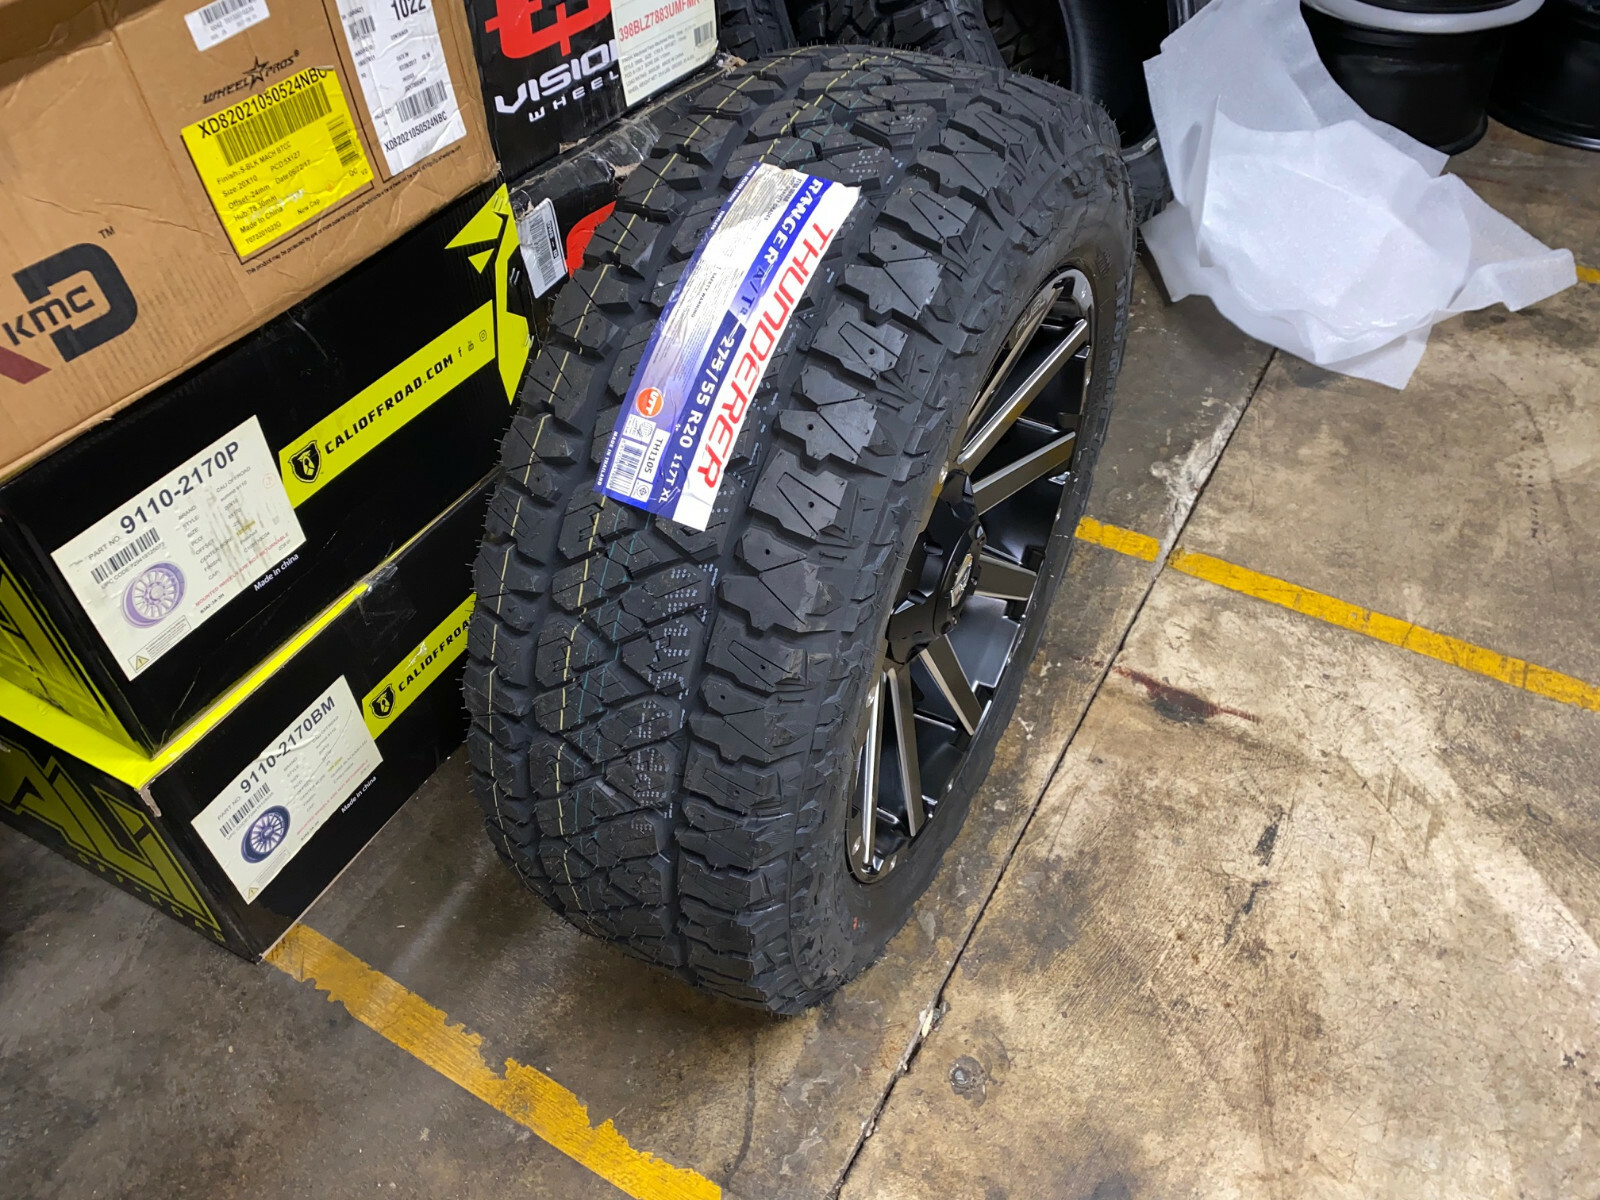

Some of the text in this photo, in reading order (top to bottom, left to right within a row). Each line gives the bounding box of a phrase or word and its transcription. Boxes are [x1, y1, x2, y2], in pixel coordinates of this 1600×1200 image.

[240, 218, 257, 234] Made
[265, 205, 283, 220] China
[762, 177, 823, 266] RANGER
[695, 334, 735, 406] 275/55
[697, 222, 834, 489] THUNDERER
[323, 354, 454, 454] CALIOFFROAD.COM
[608, 430, 618, 448] MADE
[677, 409, 703, 449] R20
[643, 436, 663, 474] TH1105
[664, 452, 682, 486] 117T
[119, 440, 242, 535] 9110-2170P
[87, 541, 108, 561] PART
[253, 552, 298, 590] Made in china
[240, 696, 335, 793] 9110-2170BM
[340, 774, 377, 813] Made in china
